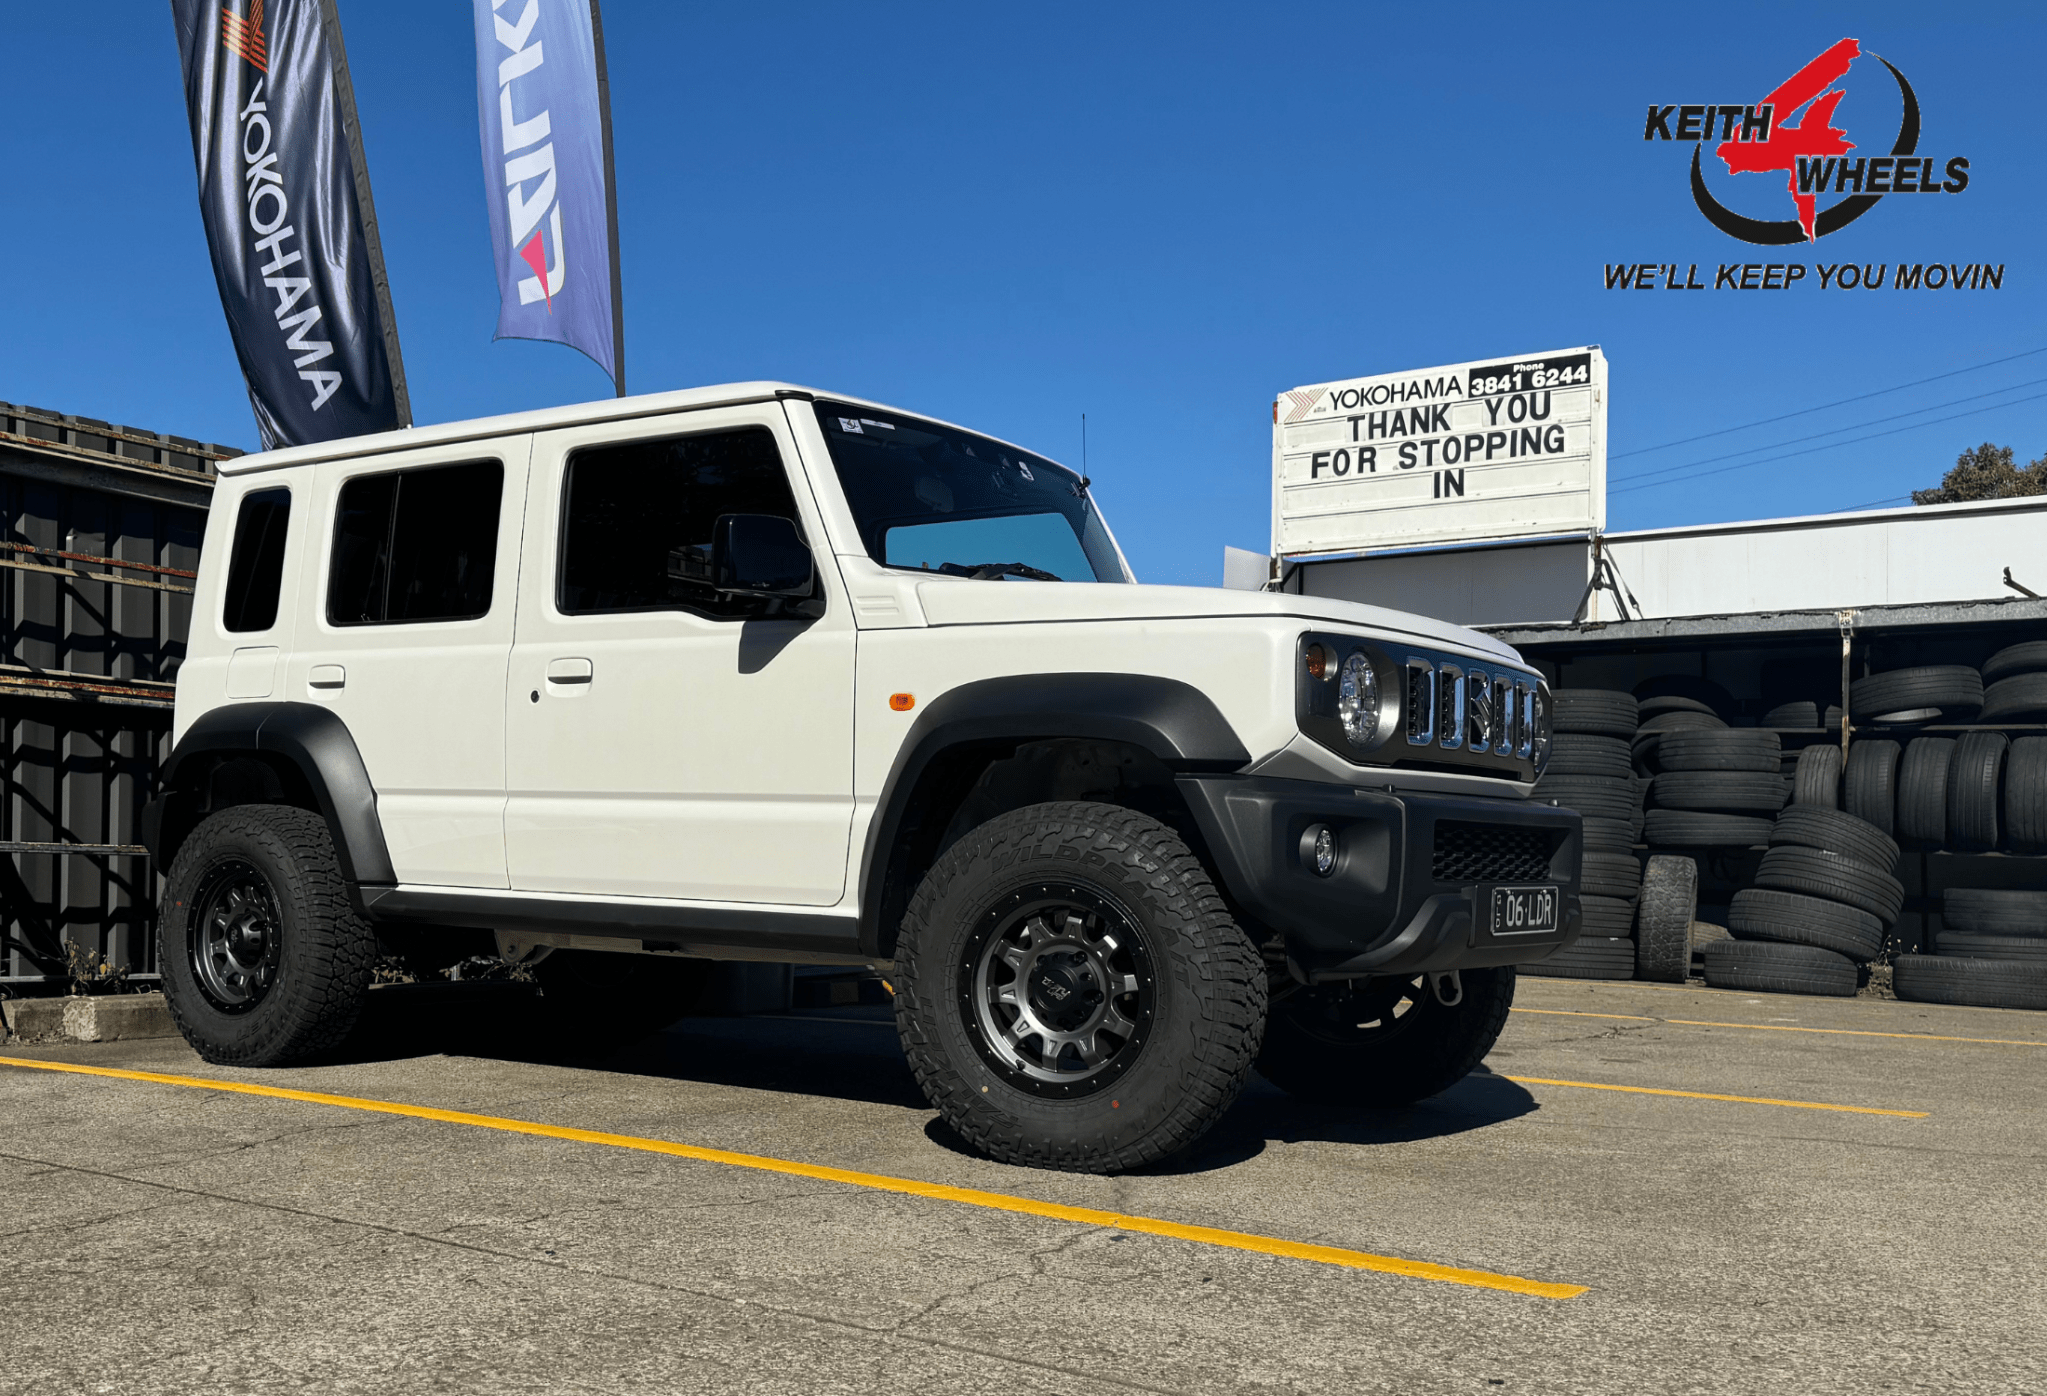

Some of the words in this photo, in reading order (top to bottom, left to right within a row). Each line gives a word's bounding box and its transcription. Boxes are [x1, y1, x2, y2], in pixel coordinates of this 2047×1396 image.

[240, 76, 343, 412] YOKOHAMA
[1470, 373, 1522, 396] 3841
[1531, 364, 1588, 388] 6244
[1513, 362, 1545, 373] Phone
[1329, 375, 1463, 412] YOKOHAMA
[1347, 402, 1452, 442] THANK
[1484, 390, 1551, 426] YOU
[1311, 446, 1377, 479] FOR
[1399, 424, 1565, 469] STOPPING
[1433, 468, 1465, 499] IN
